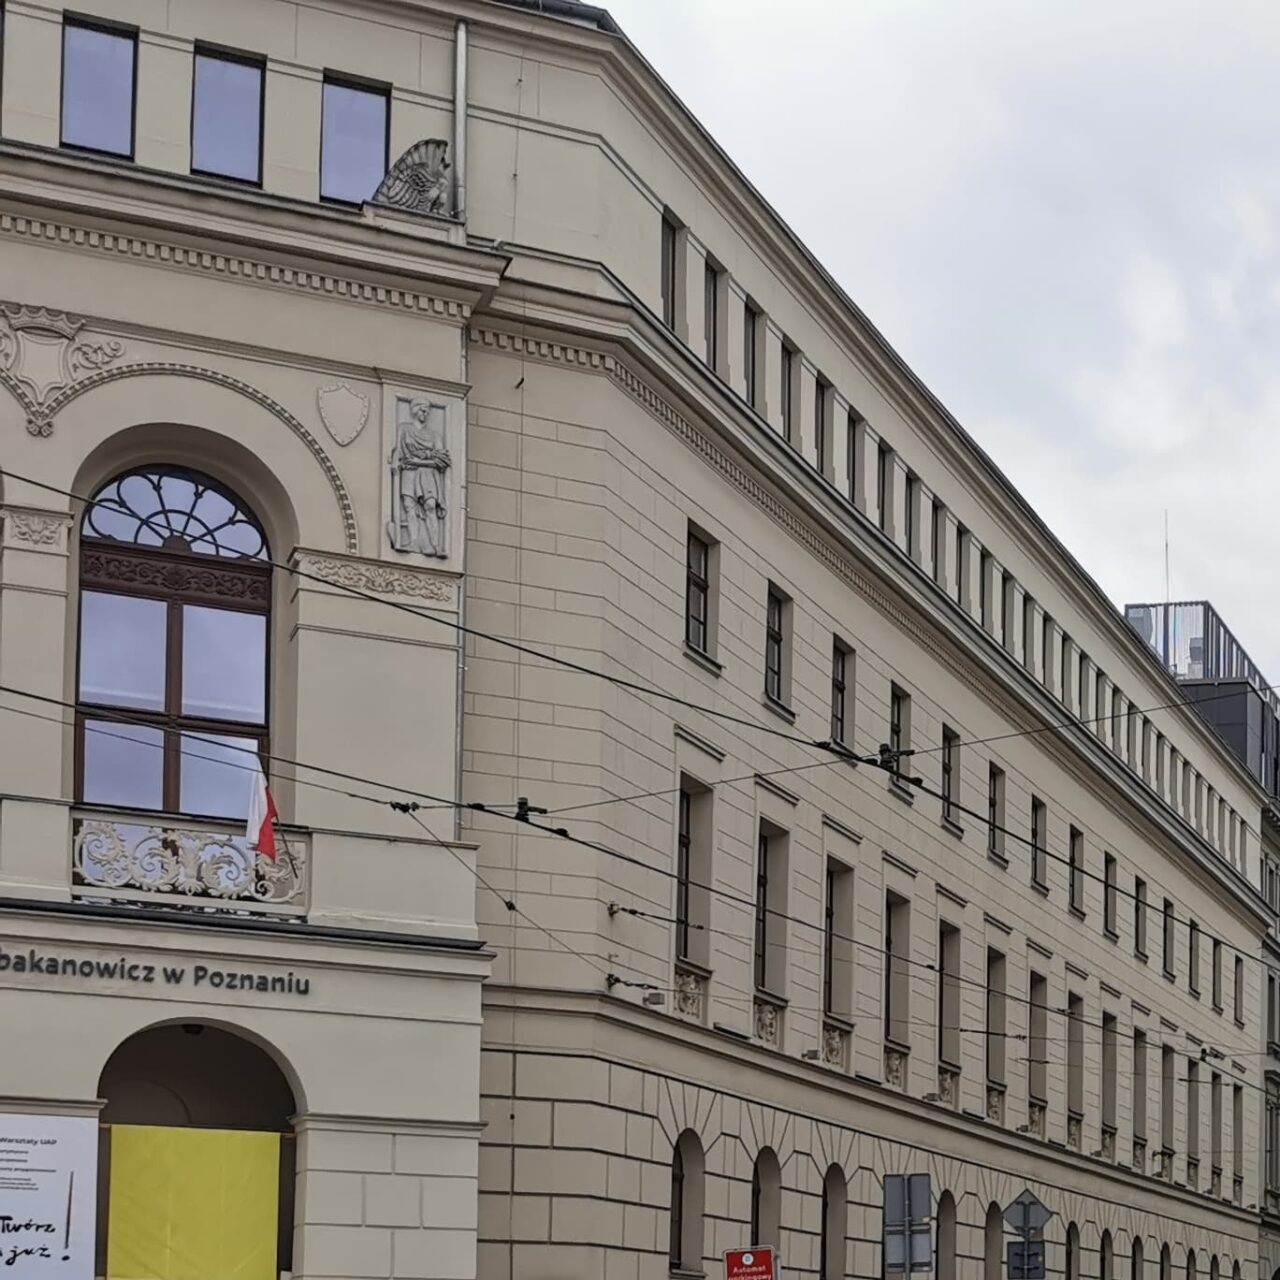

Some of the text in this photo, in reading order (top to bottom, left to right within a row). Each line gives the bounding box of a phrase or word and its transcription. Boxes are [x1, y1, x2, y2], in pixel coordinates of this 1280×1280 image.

[162, 966, 185, 985] w
[194, 965, 310, 995] Poznaniu
[734, 1265, 766, 1273] Automat
